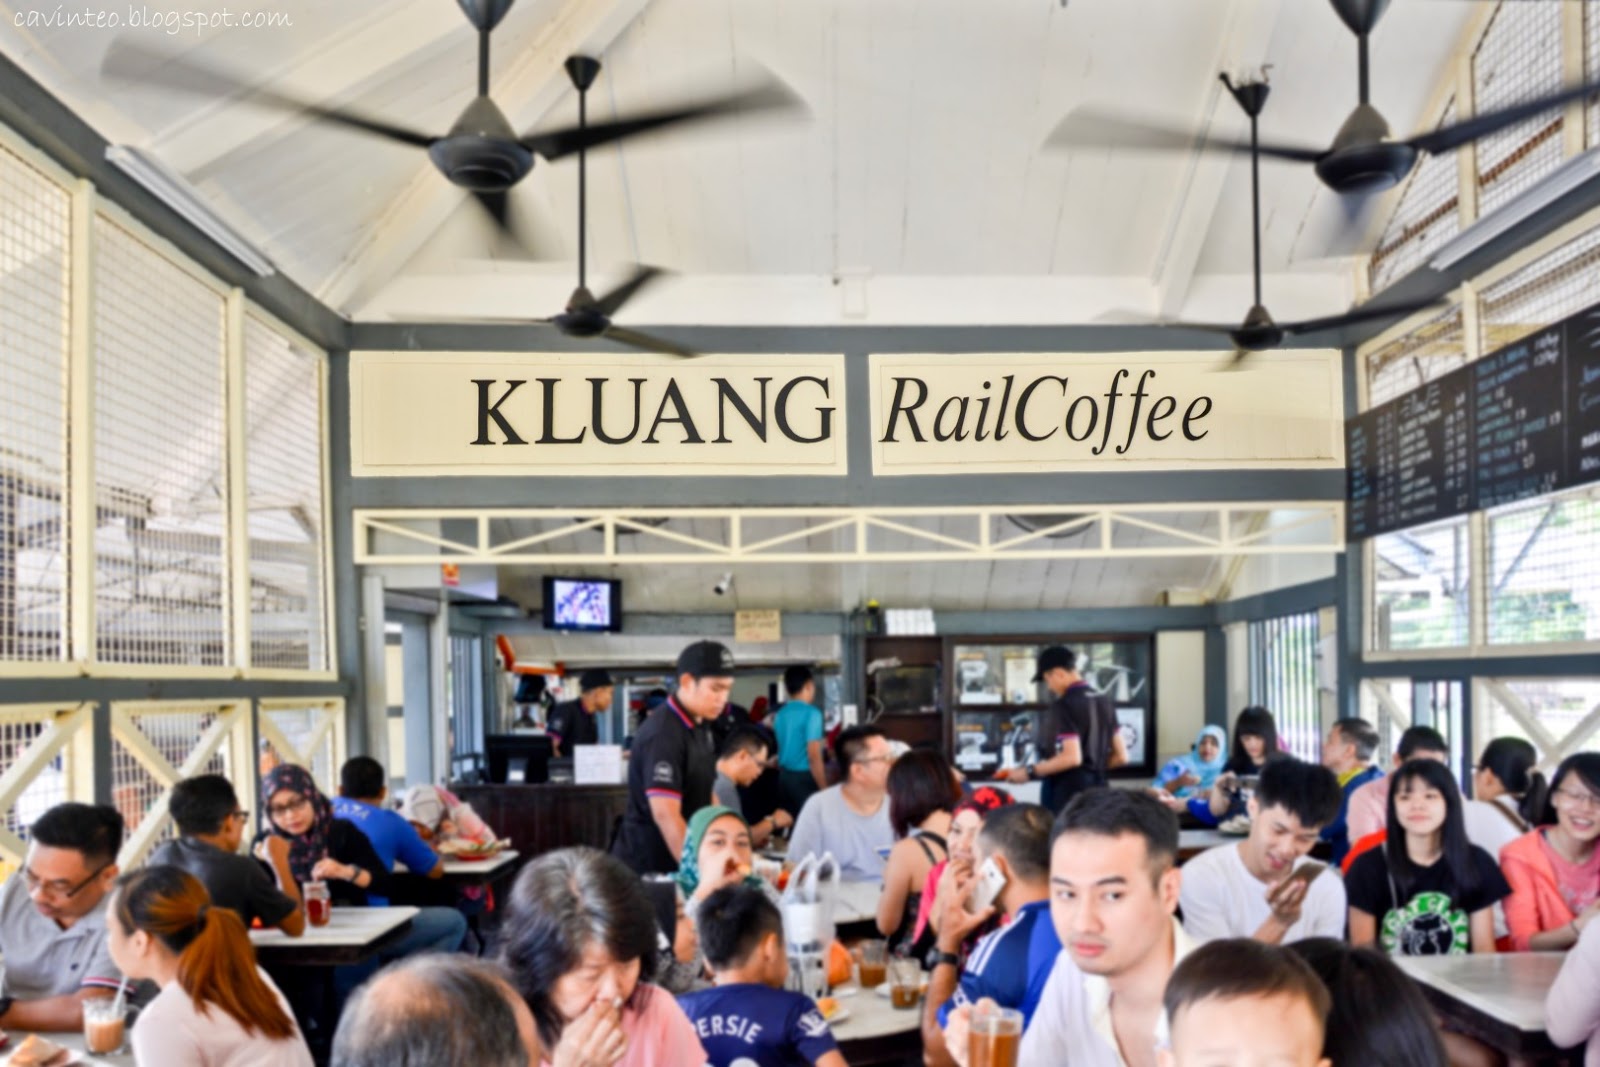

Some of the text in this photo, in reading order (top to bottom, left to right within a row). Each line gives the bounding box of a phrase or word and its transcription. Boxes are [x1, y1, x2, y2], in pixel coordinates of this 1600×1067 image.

[469, 369, 1214, 456] KLUANG RailCoffee
[690, 1014, 763, 1045] ERSIE
